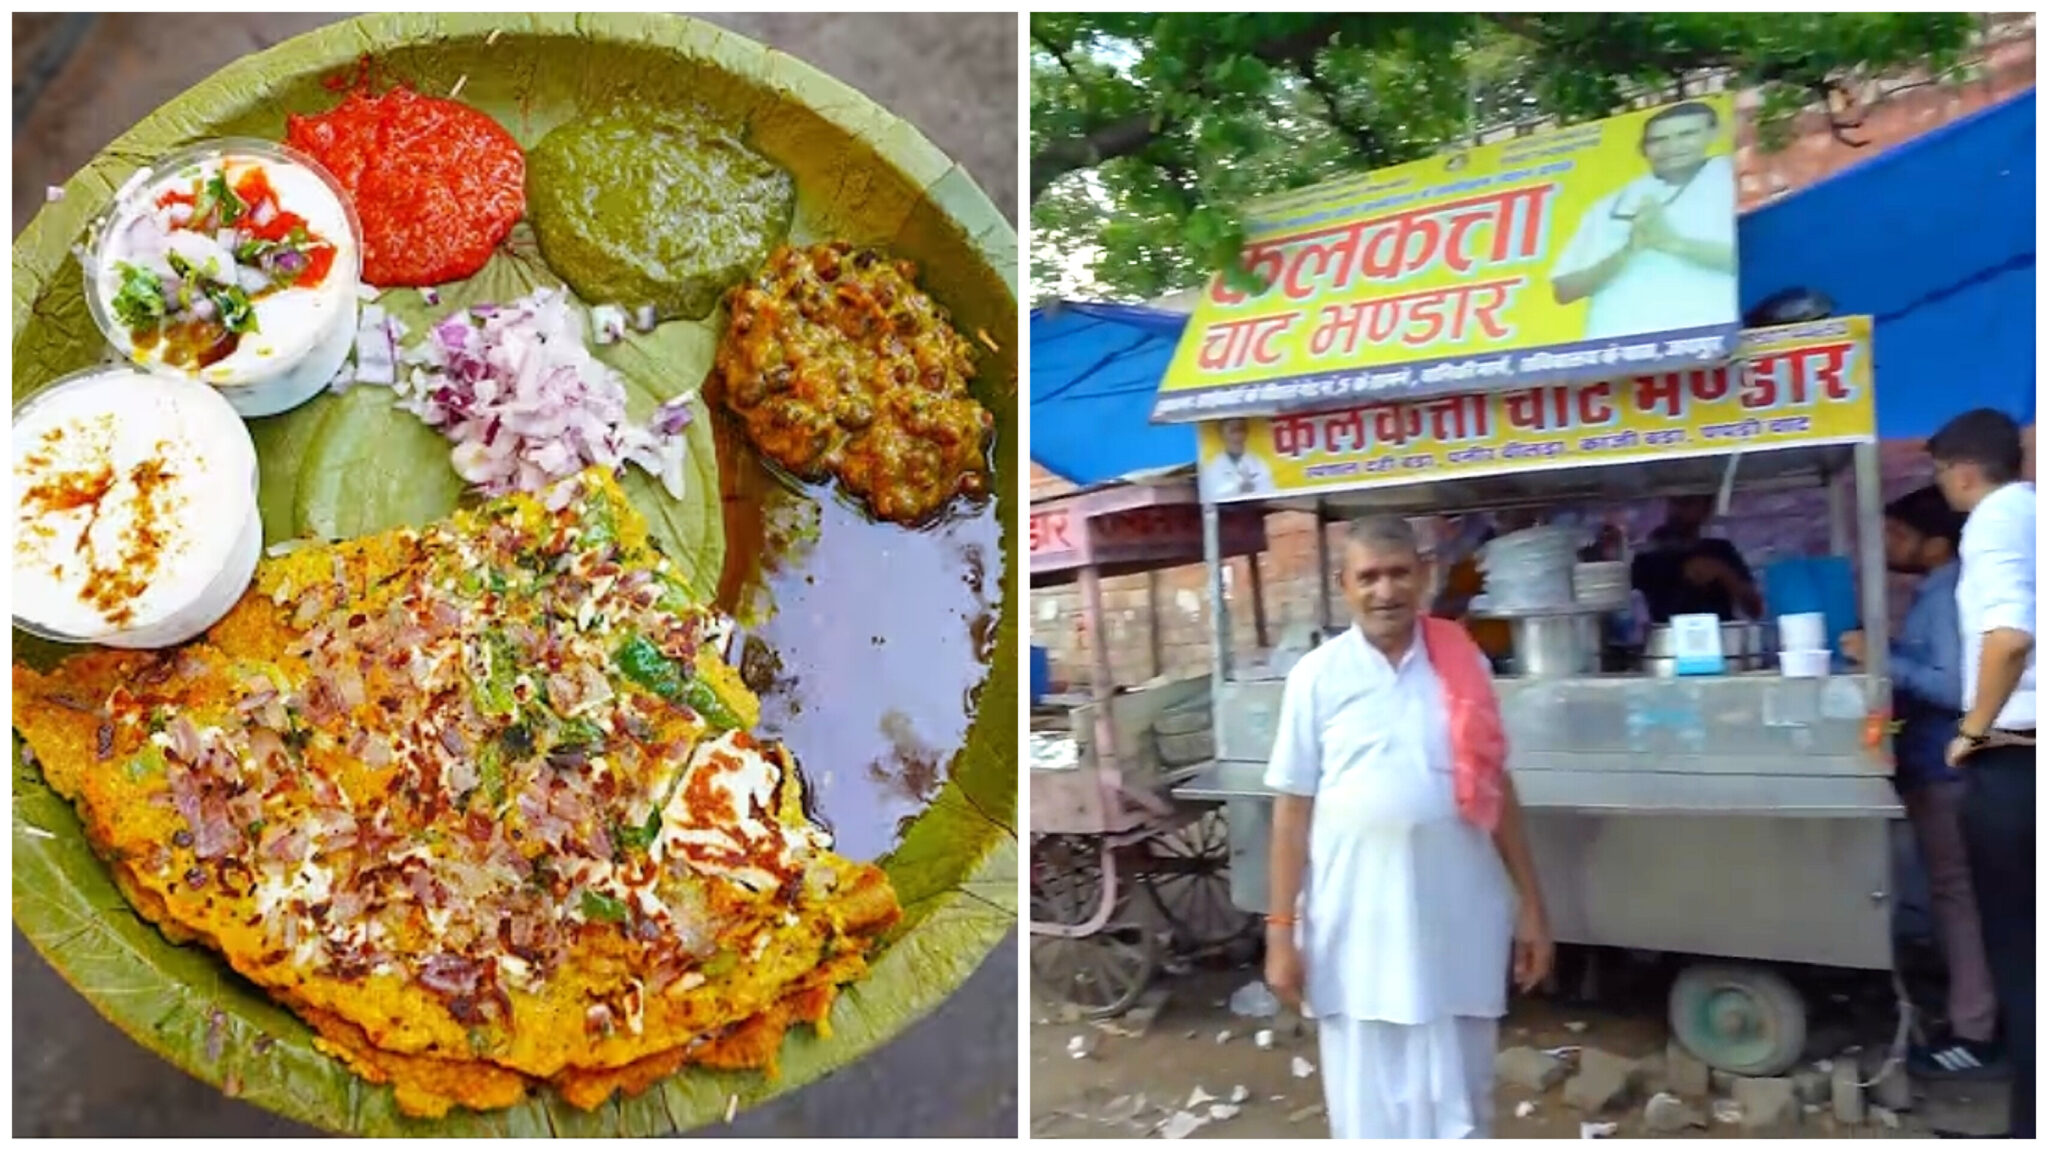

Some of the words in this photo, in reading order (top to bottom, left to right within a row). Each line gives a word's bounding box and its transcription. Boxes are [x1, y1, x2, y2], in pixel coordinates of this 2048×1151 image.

[1210, 183, 1556, 305] कलकत्ता
[1198, 312, 1301, 371] चाट
[1310, 278, 1524, 356] भण्डार
[1272, 392, 1489, 458] कलकत्ता
[1505, 380, 1614, 431] चाट
[1633, 343, 1855, 418] भण्डार
